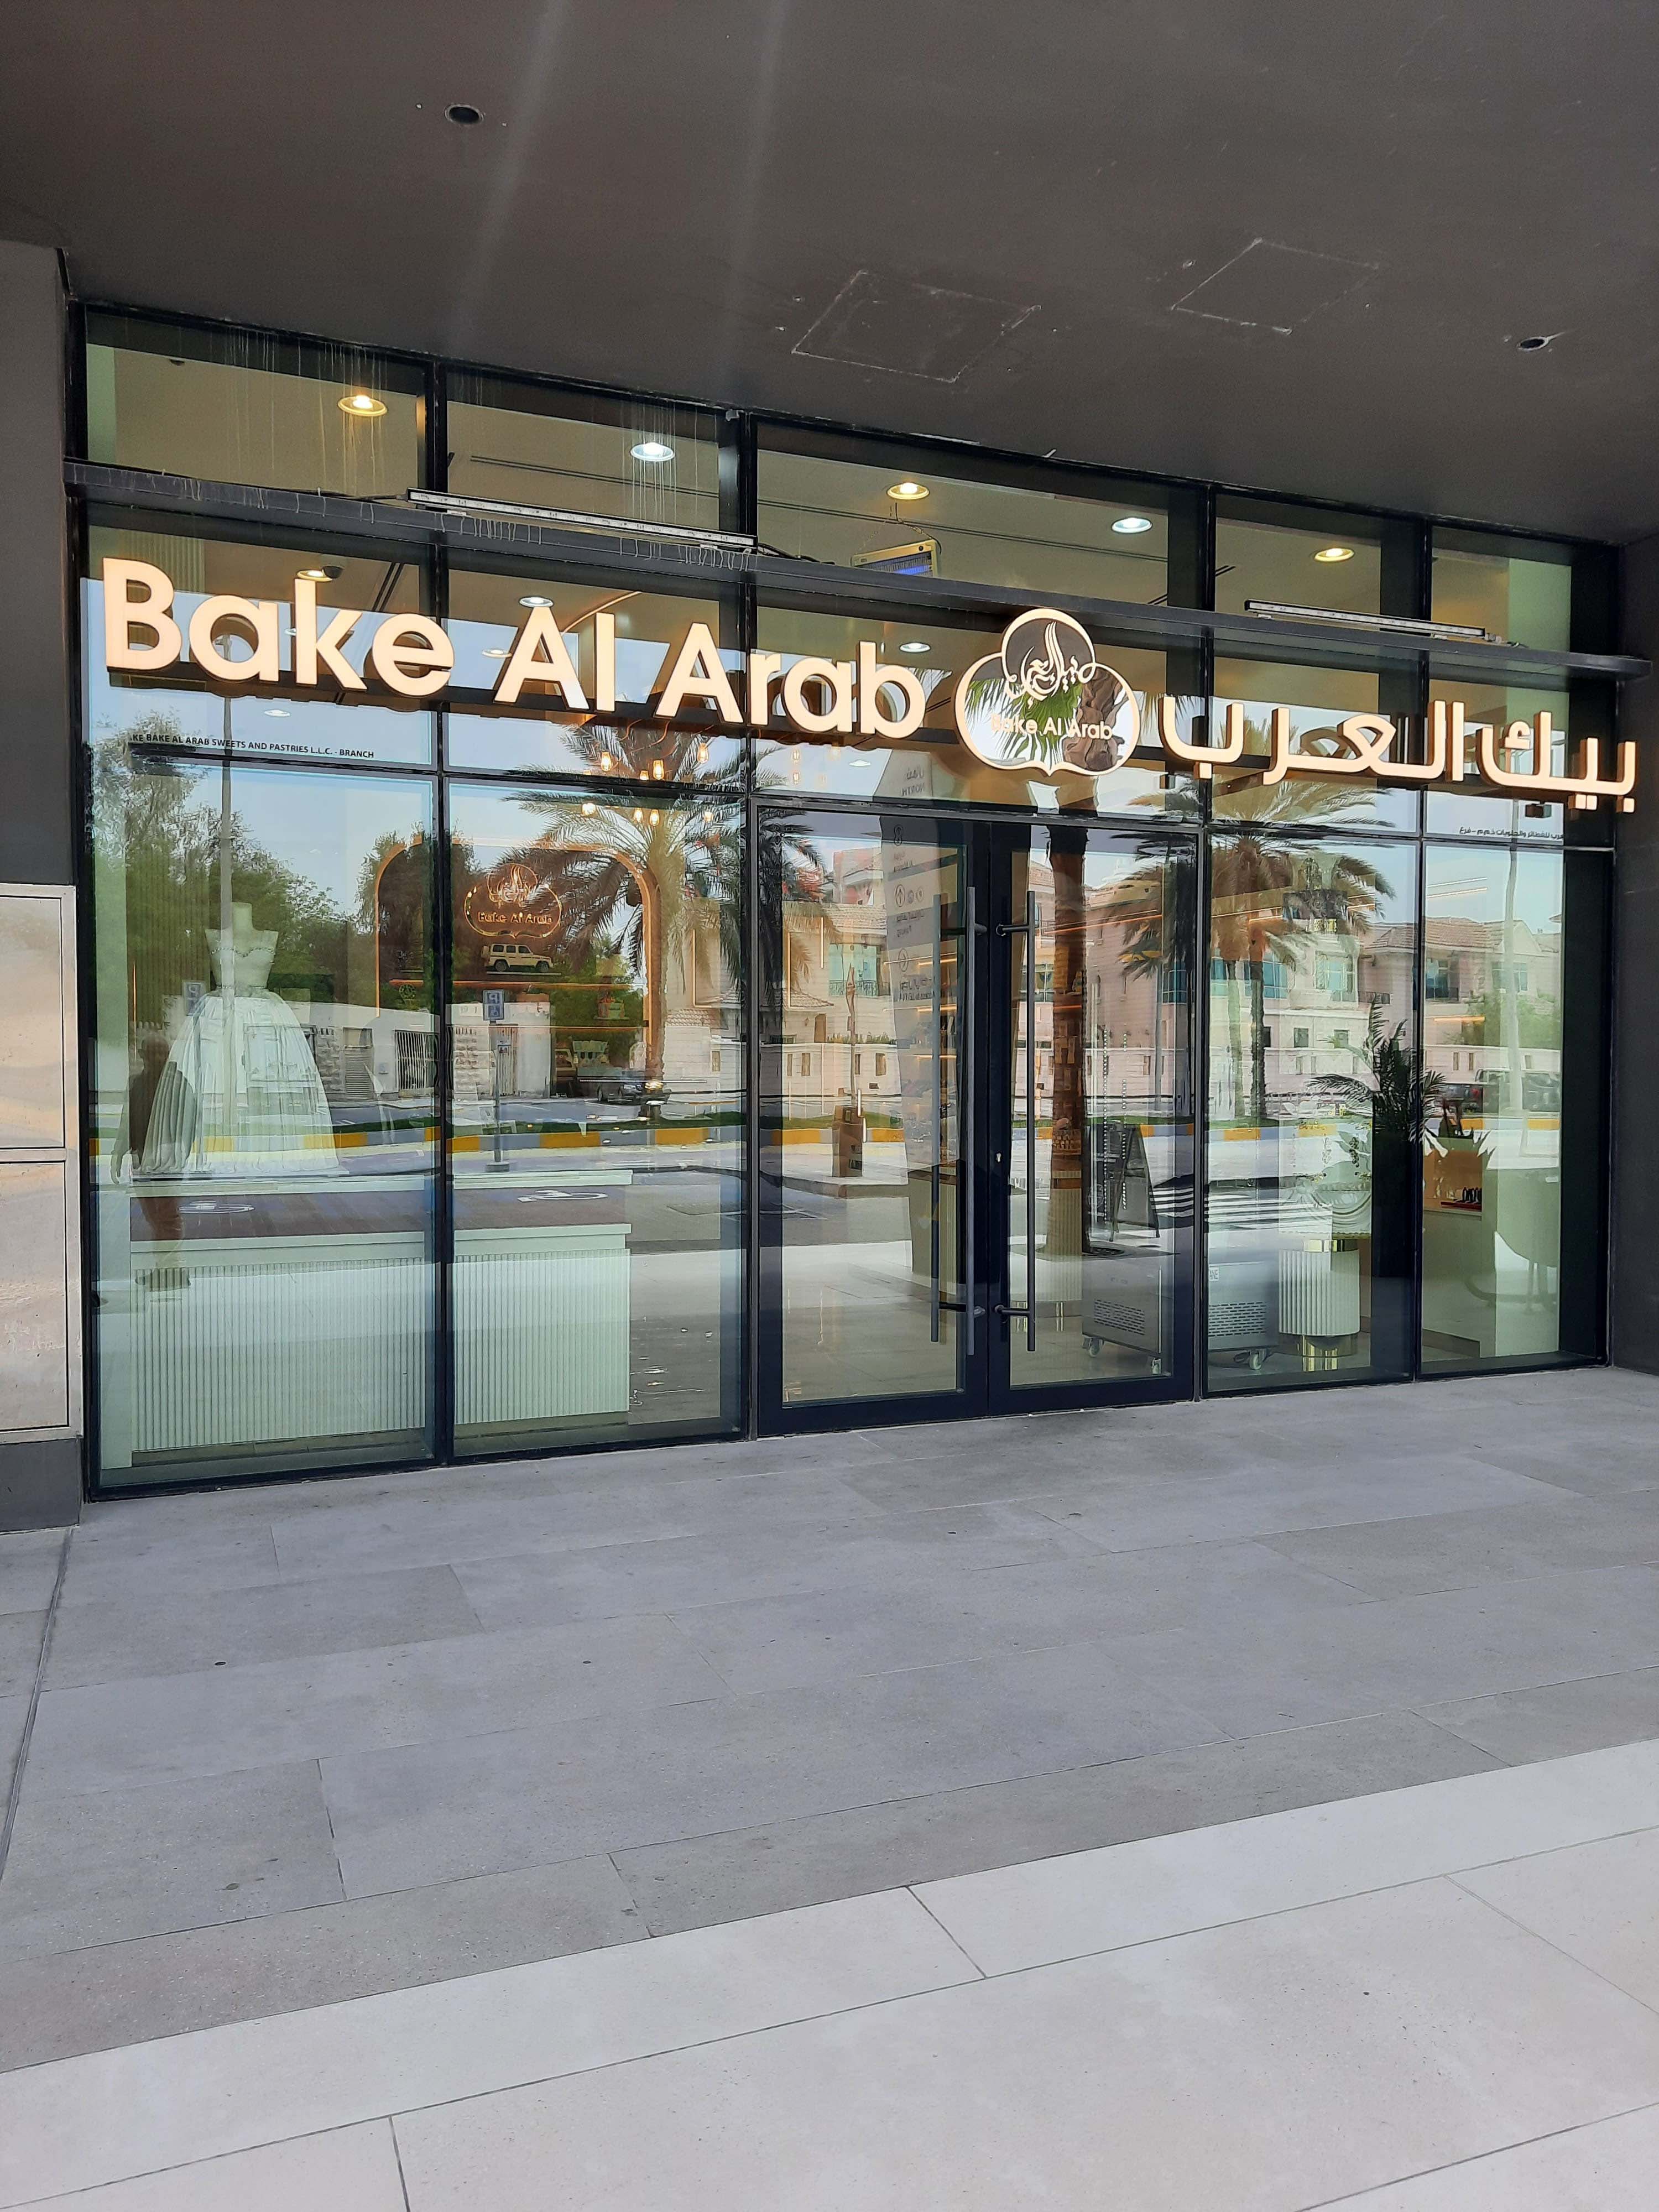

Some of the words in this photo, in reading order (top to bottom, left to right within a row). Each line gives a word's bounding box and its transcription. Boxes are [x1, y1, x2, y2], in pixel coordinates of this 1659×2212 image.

[102, 557, 455, 697] Bake
[493, 606, 615, 712] Al
[655, 622, 926, 739] Arab
[146, 734, 170, 743] BAKE
[185, 737, 210, 745] ARAB
[211, 739, 246, 748] SWEETS
[248, 742, 267, 750] AND
[269, 743, 309, 753] PASTRIES
[340, 749, 374, 758] BRANCH
[990, 713, 1038, 735] Bake
[1043, 717, 1063, 736] Al
[1068, 718, 1113, 740] Arab
[1163, 700, 1465, 786] العرب
[1478, 711, 1637, 813] بيك
